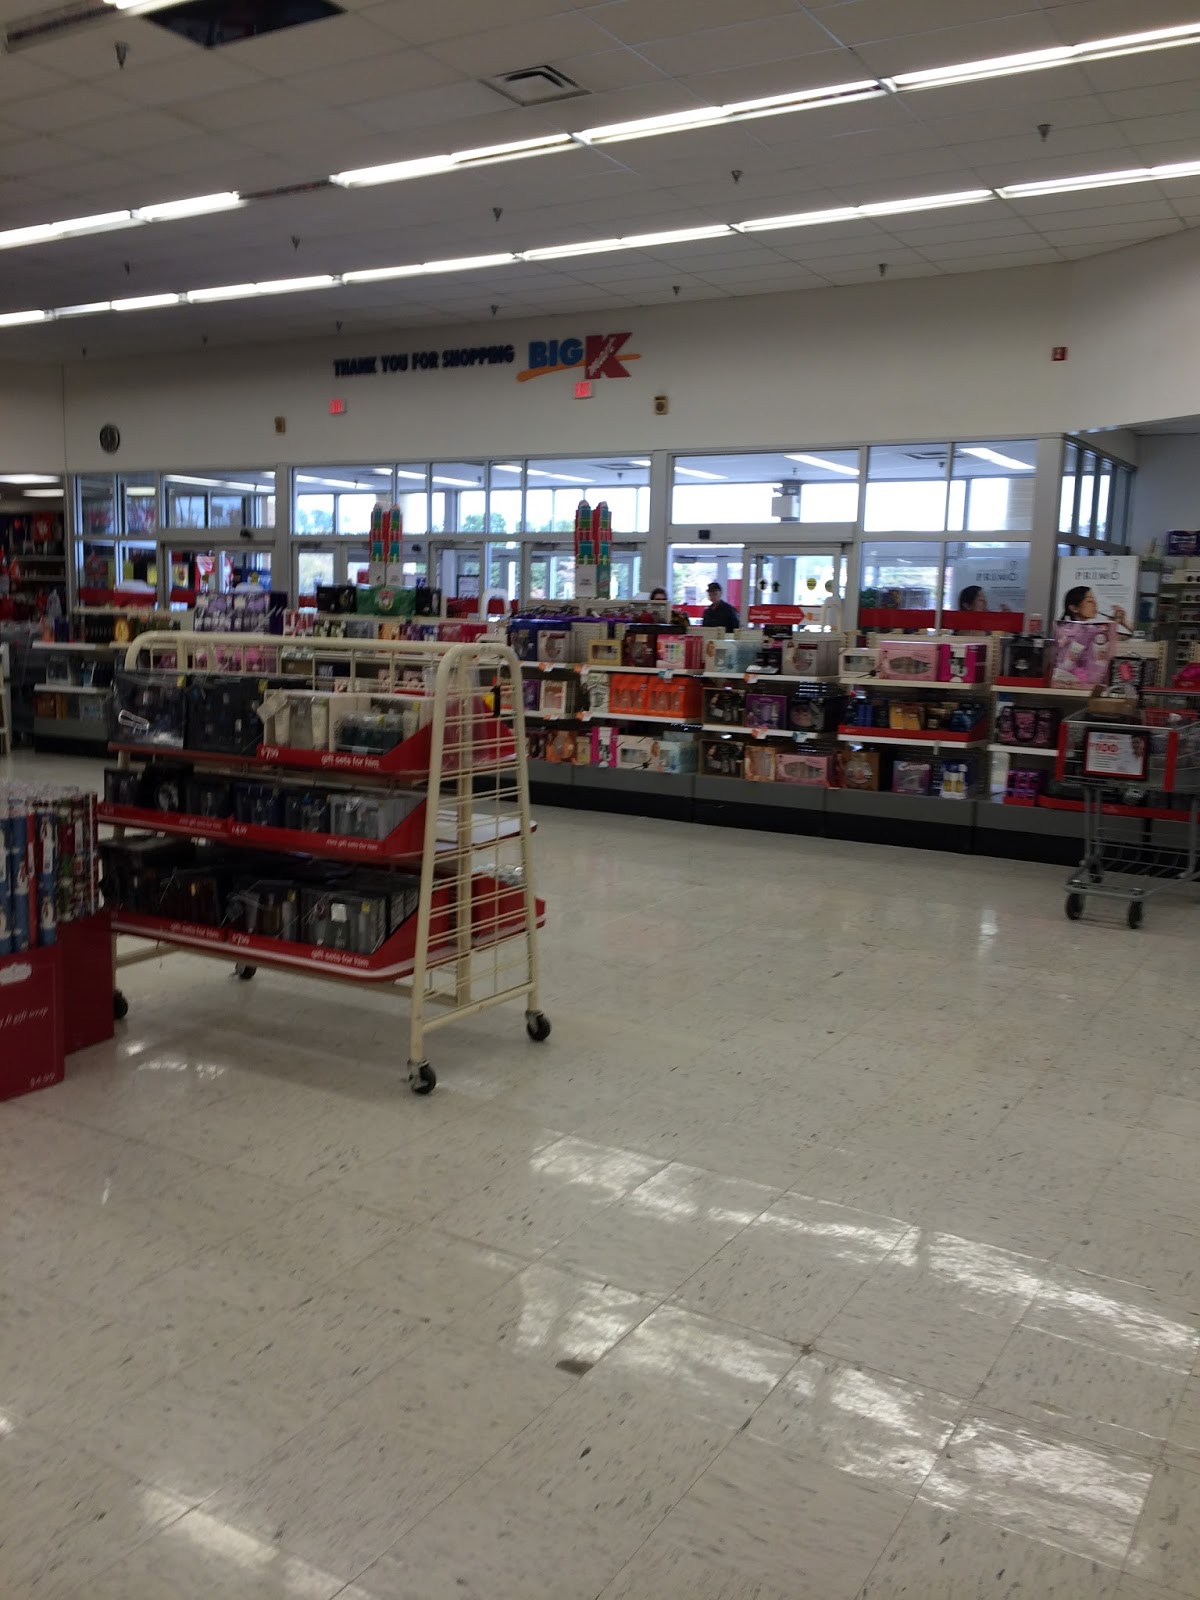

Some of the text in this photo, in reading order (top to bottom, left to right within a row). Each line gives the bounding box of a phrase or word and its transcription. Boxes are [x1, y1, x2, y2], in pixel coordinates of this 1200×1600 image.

[334, 356, 377, 376] THANK
[381, 353, 408, 373] YOU
[411, 350, 439, 370] FOR
[442, 344, 515, 367] SHOPPING
[528, 338, 583, 369] BIG
[585, 332, 633, 379] K
